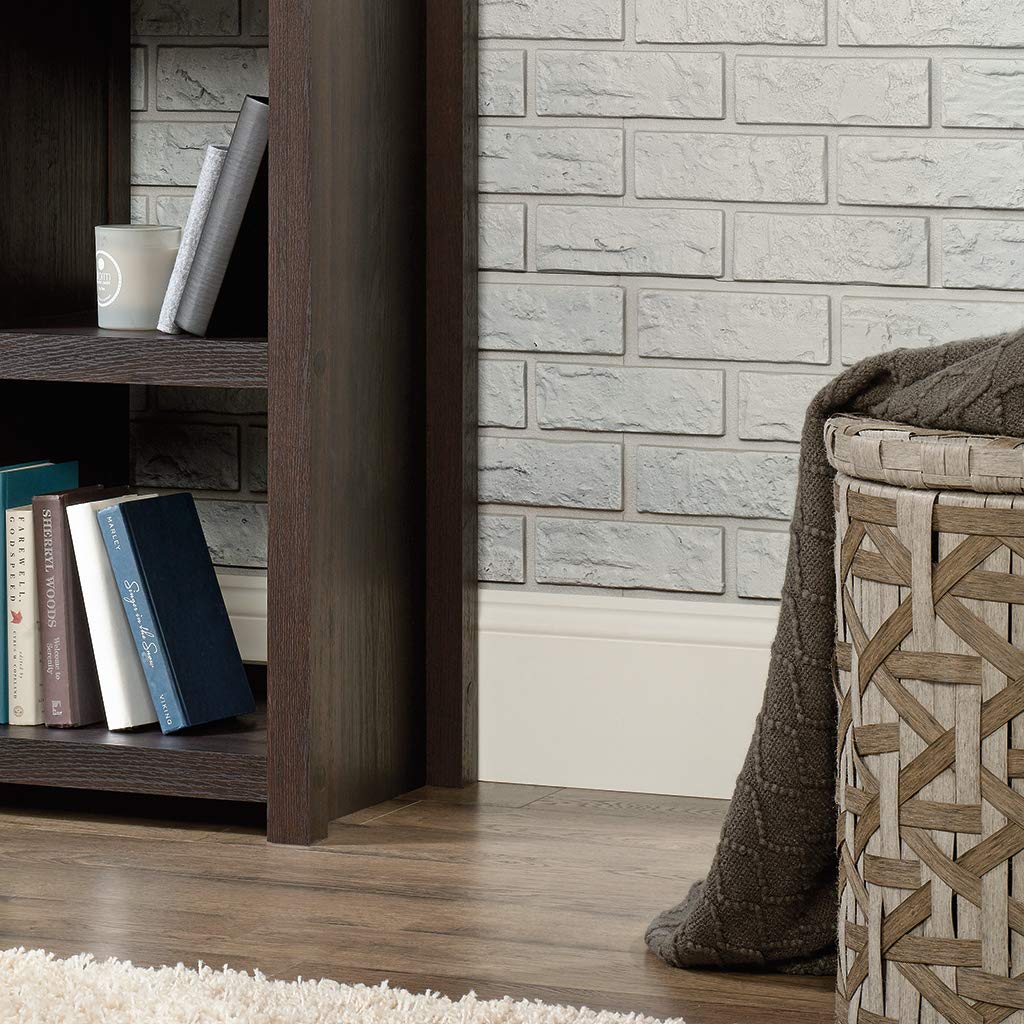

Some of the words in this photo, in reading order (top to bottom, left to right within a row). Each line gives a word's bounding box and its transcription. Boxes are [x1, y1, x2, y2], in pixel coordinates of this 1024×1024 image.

[42, 508, 55, 573] SHERRYL
[106, 515, 121, 551] MARLEY
[46, 576, 57, 628] WOODS
[123, 579, 139, 610] Singer
[134, 613, 144, 624] in
[139, 625, 154, 641] the
[46, 642, 54, 675] Serenity
[53, 637, 61, 670] Welcome
[142, 641, 157, 668] Snow
[55, 672, 61, 680] to
[159, 693, 173, 726] VIKING
